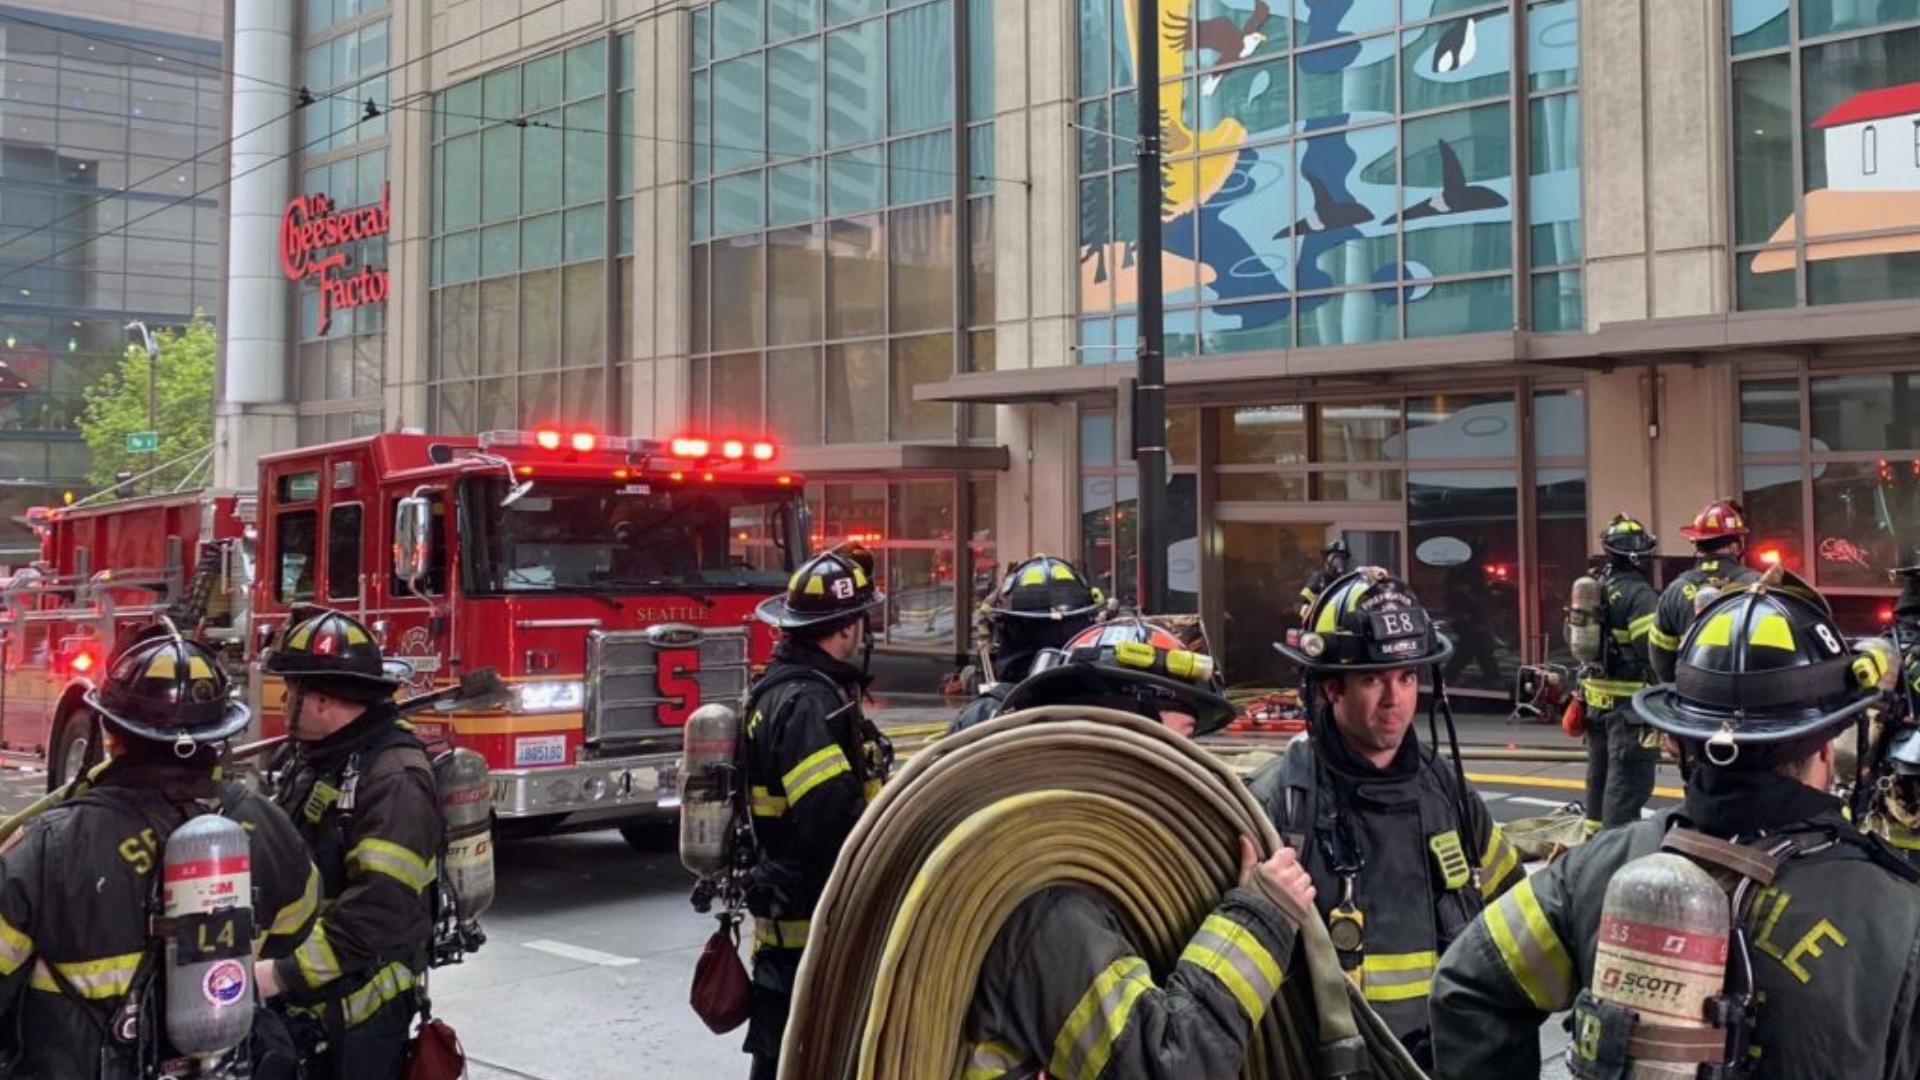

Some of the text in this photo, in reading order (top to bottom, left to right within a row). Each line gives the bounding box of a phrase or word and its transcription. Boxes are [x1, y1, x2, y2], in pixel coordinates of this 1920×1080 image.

[636, 608, 708, 621] SEATTLE
[1383, 613, 1414, 634] E8
[319, 636, 332, 653] 4
[1815, 623, 1840, 654] 8
[657, 650, 700, 727] 5
[208, 881, 233, 895] 3M
[198, 919, 235, 953] L4
[1623, 972, 1687, 996] SCOTT
